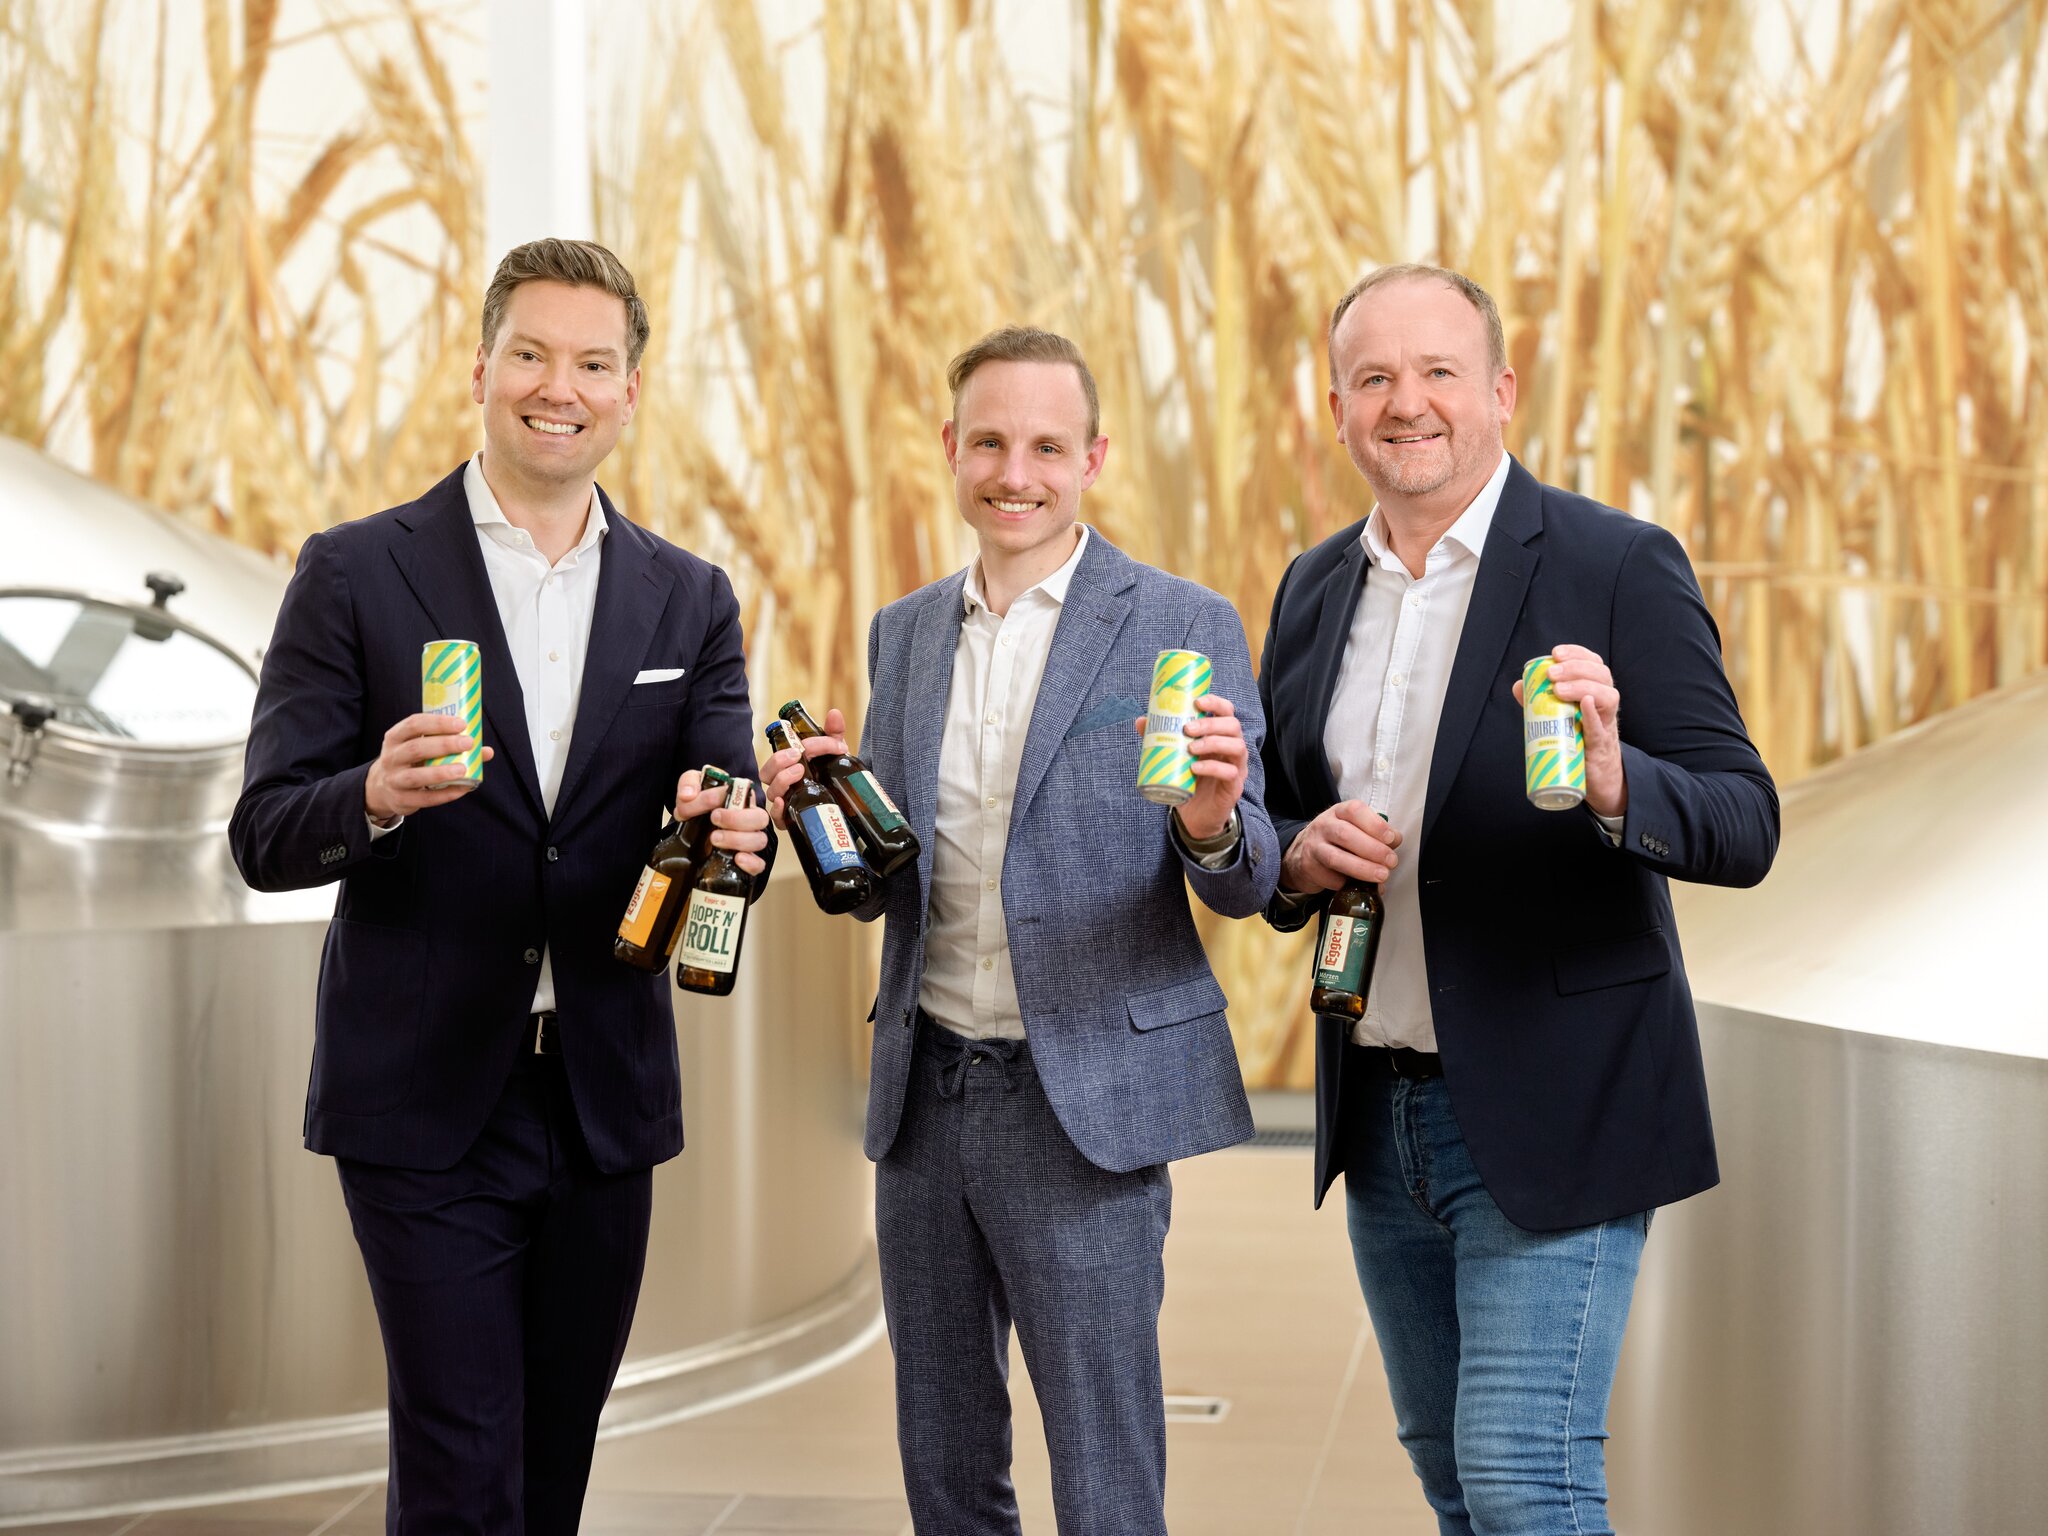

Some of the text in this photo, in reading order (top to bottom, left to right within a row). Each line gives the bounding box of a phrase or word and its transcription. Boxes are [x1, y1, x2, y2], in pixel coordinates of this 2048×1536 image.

[830, 815, 850, 848] Egger
[626, 879, 646, 916] Egger
[691, 904, 721, 925] HOPF
[686, 921, 730, 955] ROLL
[1324, 928, 1343, 967] Egger
